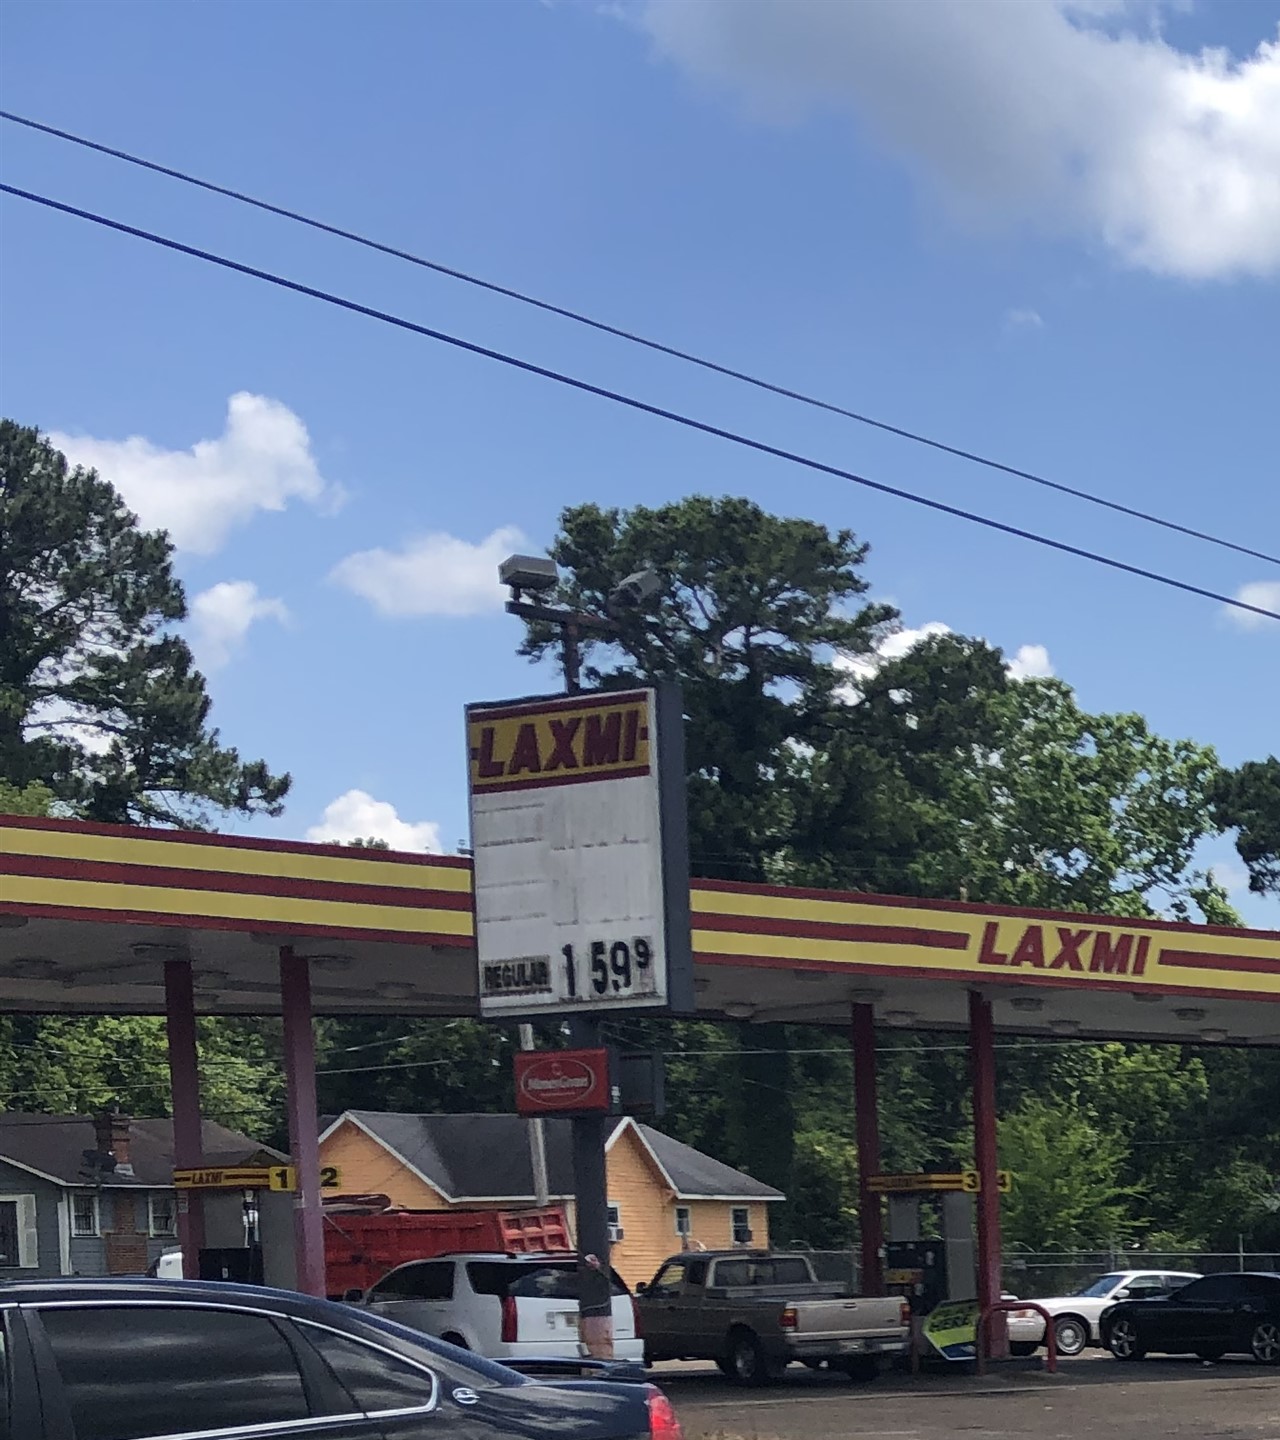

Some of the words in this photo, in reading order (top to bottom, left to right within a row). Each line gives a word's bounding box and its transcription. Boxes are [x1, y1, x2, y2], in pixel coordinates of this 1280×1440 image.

[478, 710, 639, 778] LAXMI
[977, 921, 1153, 977] LAXMI
[484, 961, 548, 989] REGULAR
[191, 1170, 224, 1185] LAXMI
[275, 1168, 288, 1188] 1
[320, 1167, 338, 1187] 2
[966, 1172, 978, 1189] 3
